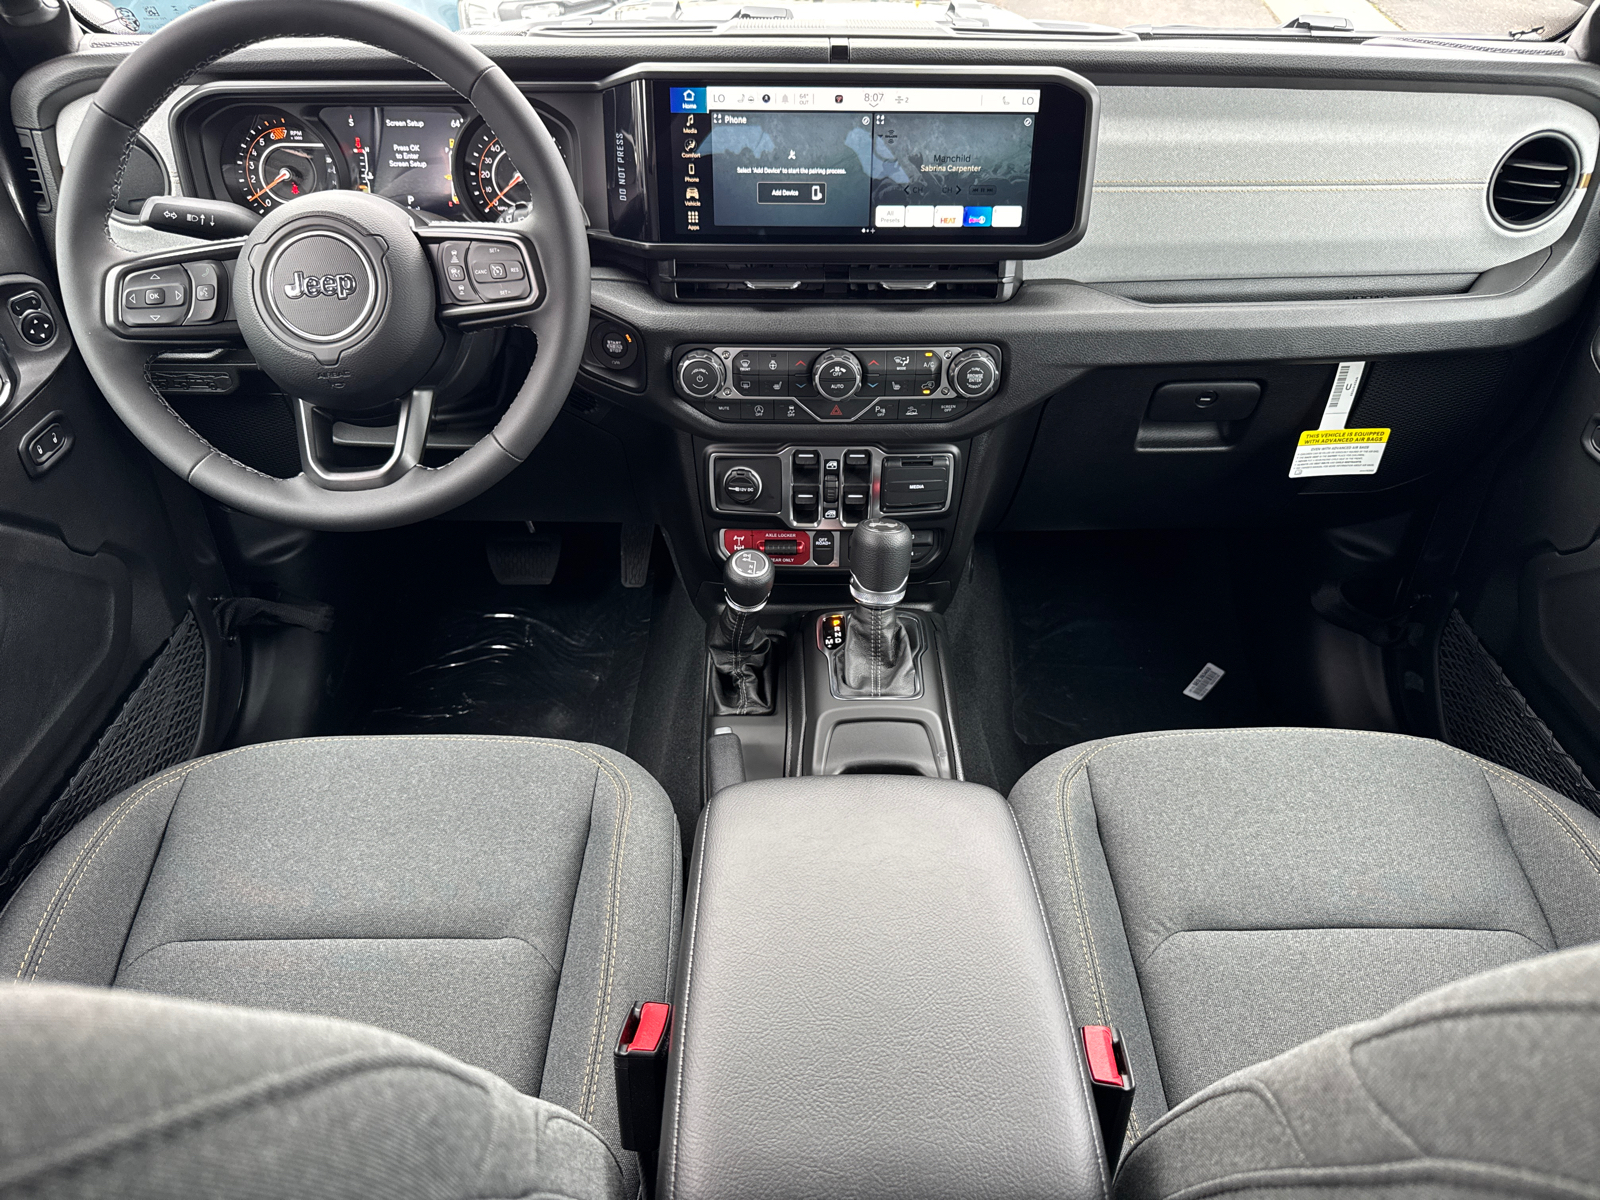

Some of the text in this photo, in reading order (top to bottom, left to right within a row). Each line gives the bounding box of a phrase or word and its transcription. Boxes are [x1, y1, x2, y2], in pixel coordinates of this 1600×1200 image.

[713, 94, 725, 102] LO
[864, 93, 884, 102] 8:07
[1022, 97, 1034, 105] LO
[724, 114, 747, 124] Phone
[407, 120, 424, 128] Setup
[616, 133, 624, 164] PRESS
[933, 154, 971, 163] Manchild
[920, 164, 981, 173] Sabrina Carpenter
[619, 188, 626, 201] DO
[284, 271, 357, 300] Jeep
